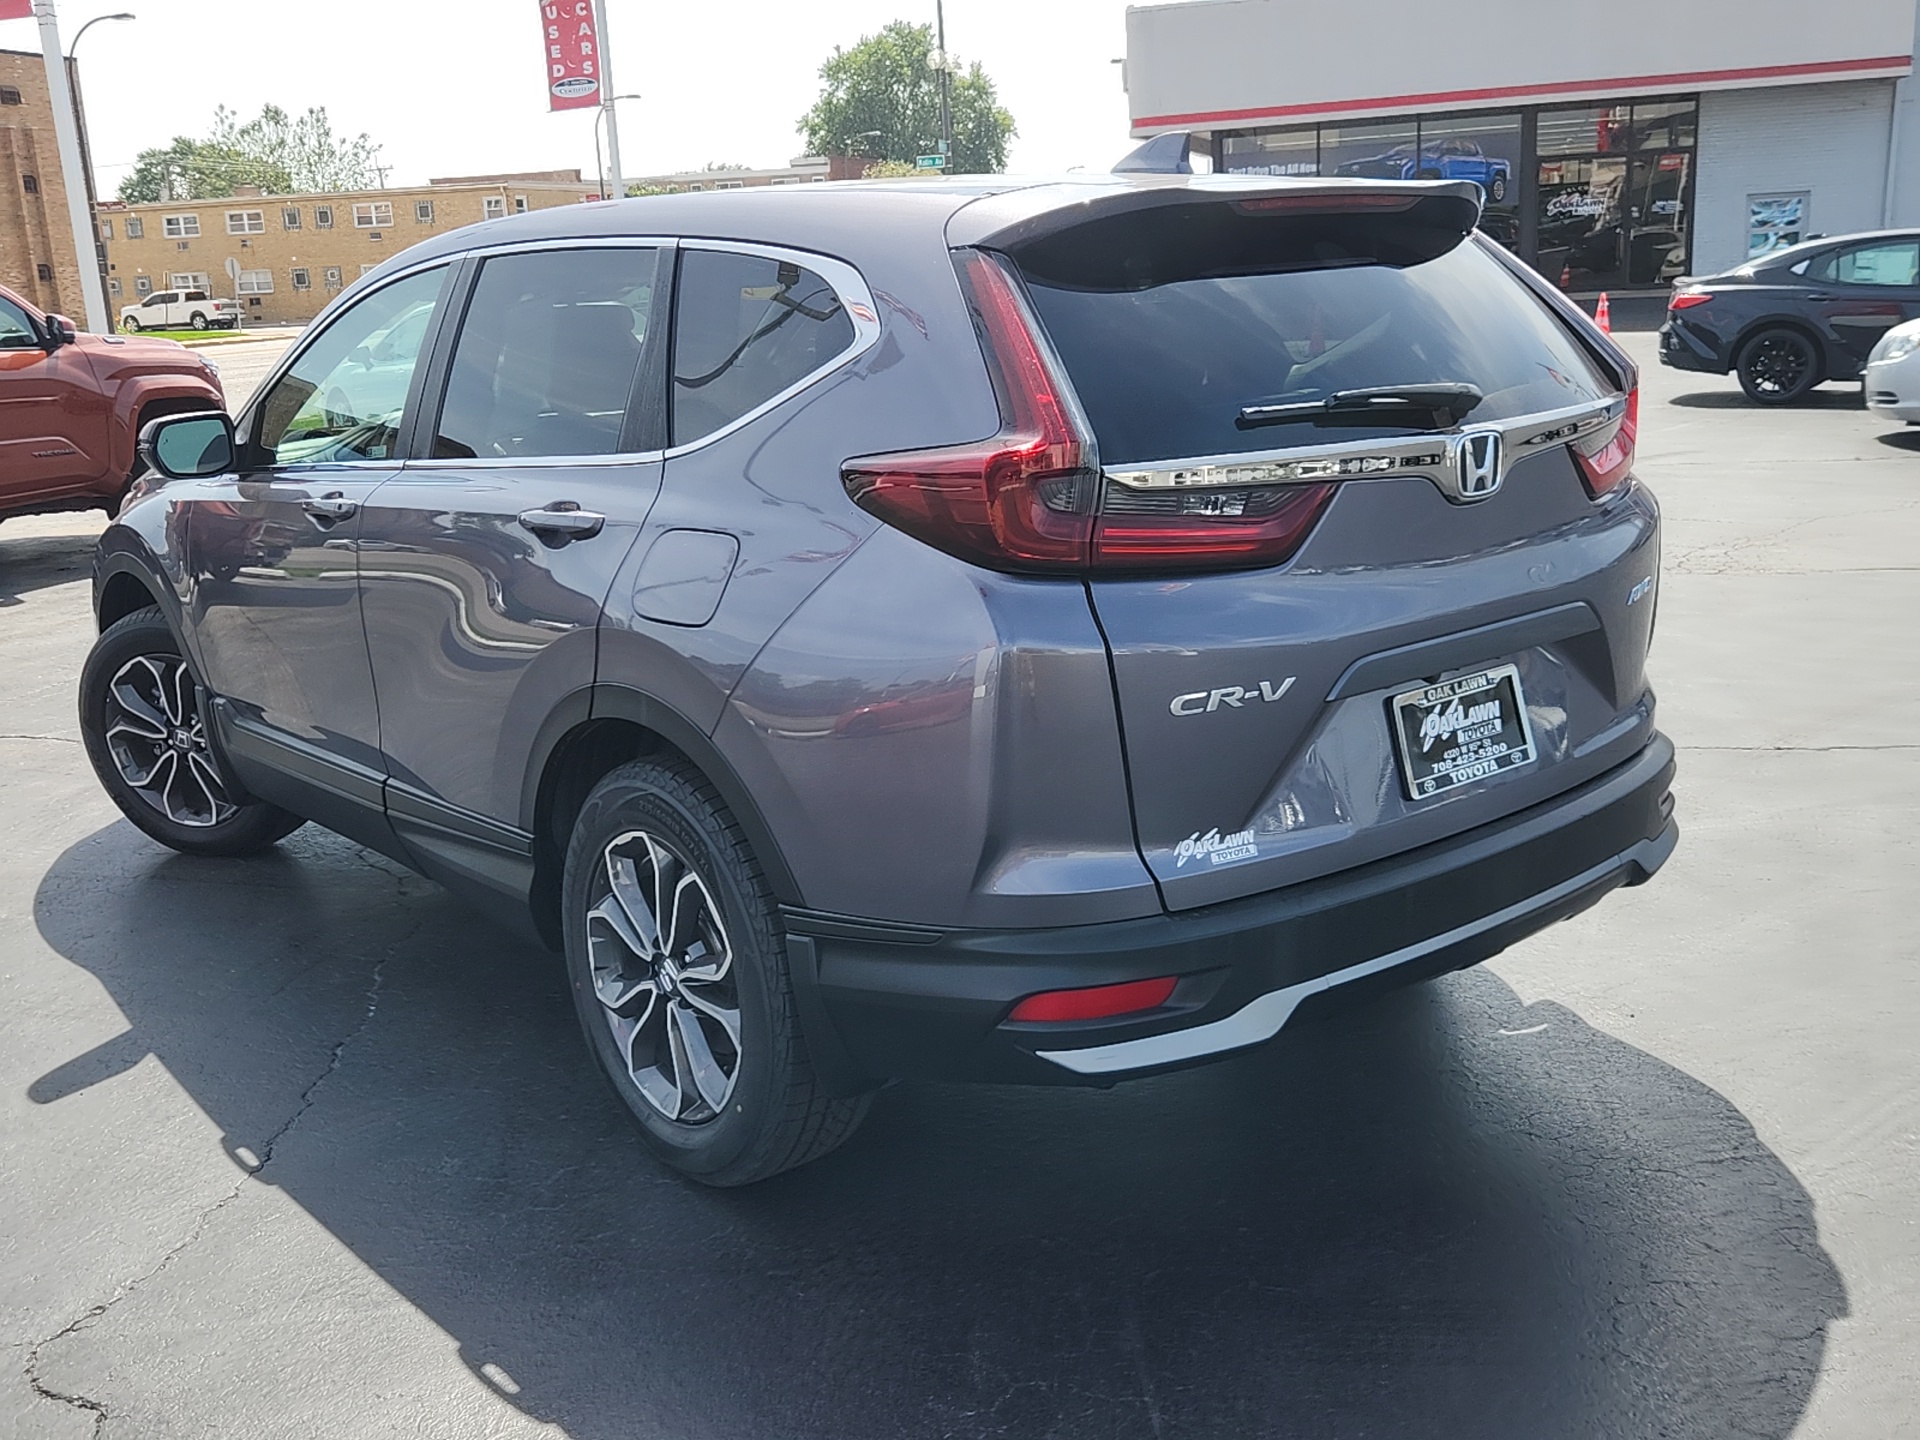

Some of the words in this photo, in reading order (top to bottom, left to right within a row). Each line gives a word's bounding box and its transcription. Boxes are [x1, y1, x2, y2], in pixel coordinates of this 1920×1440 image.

[545, 6, 565, 77] USED
[575, 2, 593, 74] CARS
[1270, 164, 1286, 175] The
[1170, 677, 1297, 717] CR-V
[1427, 686, 1453, 701] OAK
[1454, 675, 1488, 694] LAWN
[1462, 722, 1499, 741] TOYOTA
[1431, 742, 1508, 774] 708-423-5200
[1449, 759, 1499, 784] TOYOTA
[1215, 846, 1251, 861] TOYOTA
